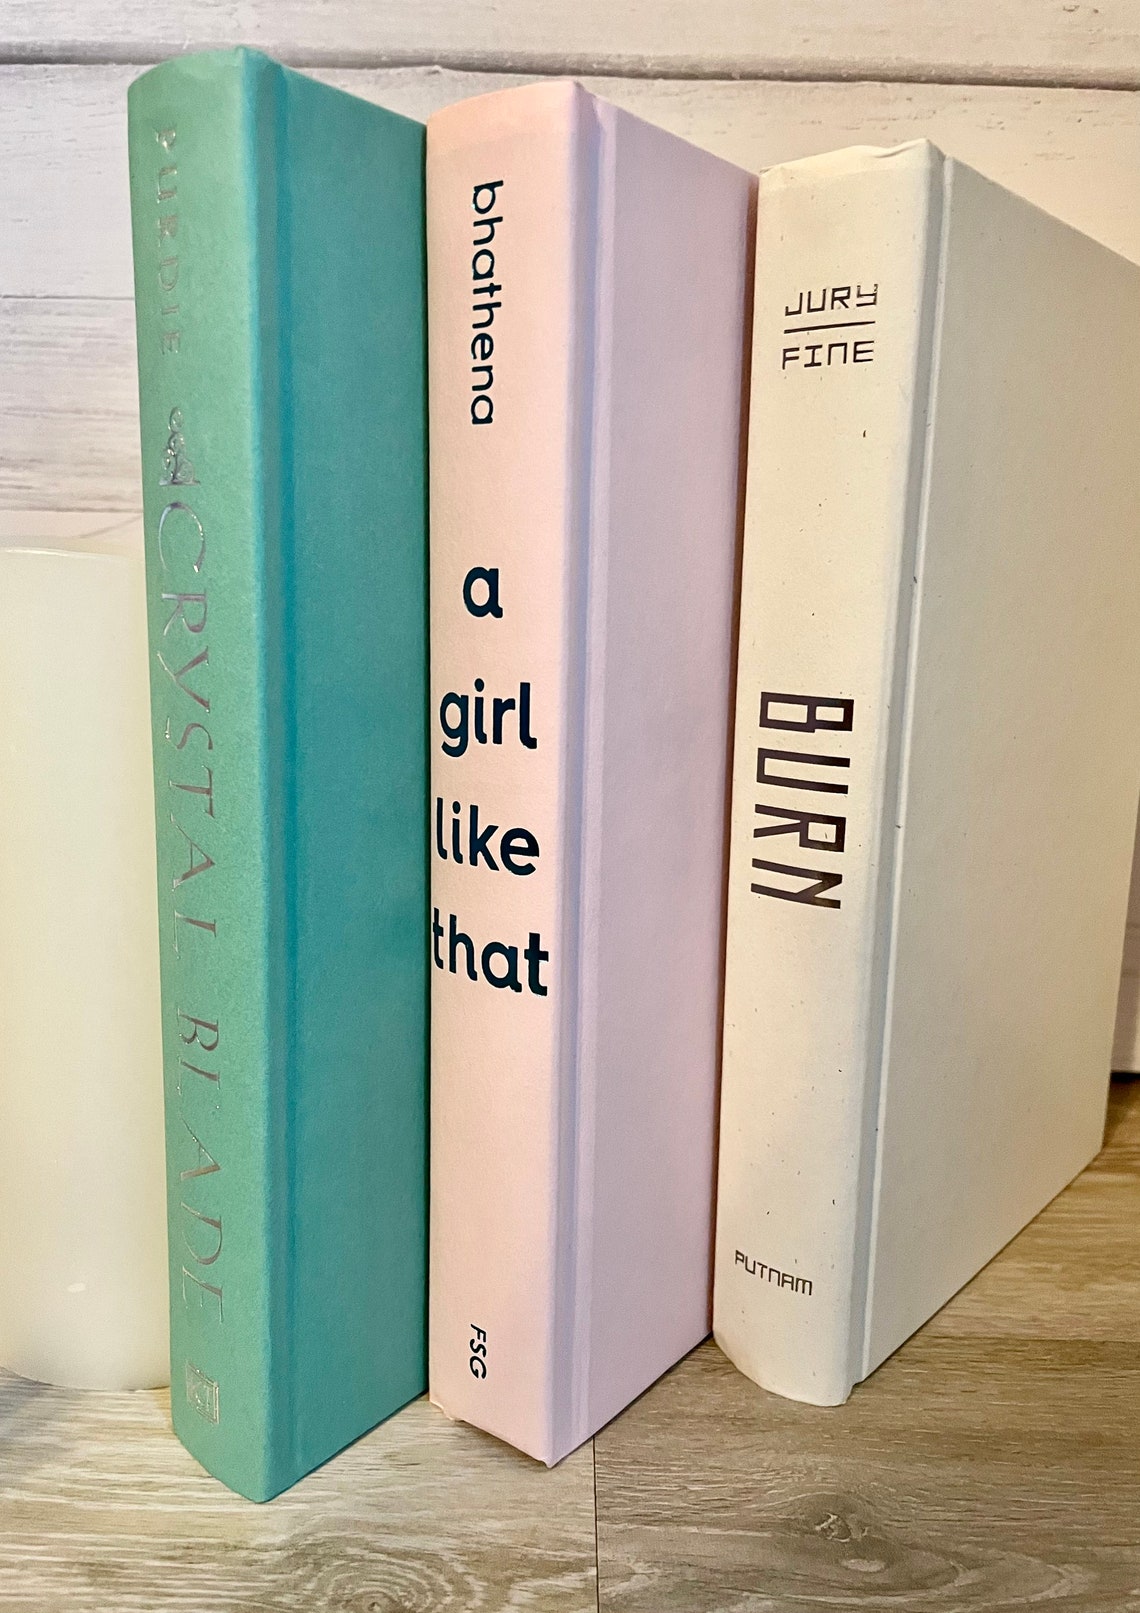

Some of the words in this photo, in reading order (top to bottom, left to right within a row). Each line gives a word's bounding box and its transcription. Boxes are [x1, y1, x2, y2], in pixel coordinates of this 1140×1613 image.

[155, 127, 181, 355] PURDIE
[471, 180, 504, 425] bhathena
[784, 284, 879, 317] JURY
[782, 340, 875, 370] FINE
[462, 566, 504, 619] a
[157, 501, 217, 962] CRYSTAL
[440, 677, 538, 758] girl
[436, 796, 540, 876] like
[750, 691, 855, 910] BURN
[433, 906, 549, 997] that
[176, 1006, 225, 1325] BLADE
[734, 1249, 813, 1296] PUTNAM
[469, 1323, 487, 1380] FSG
